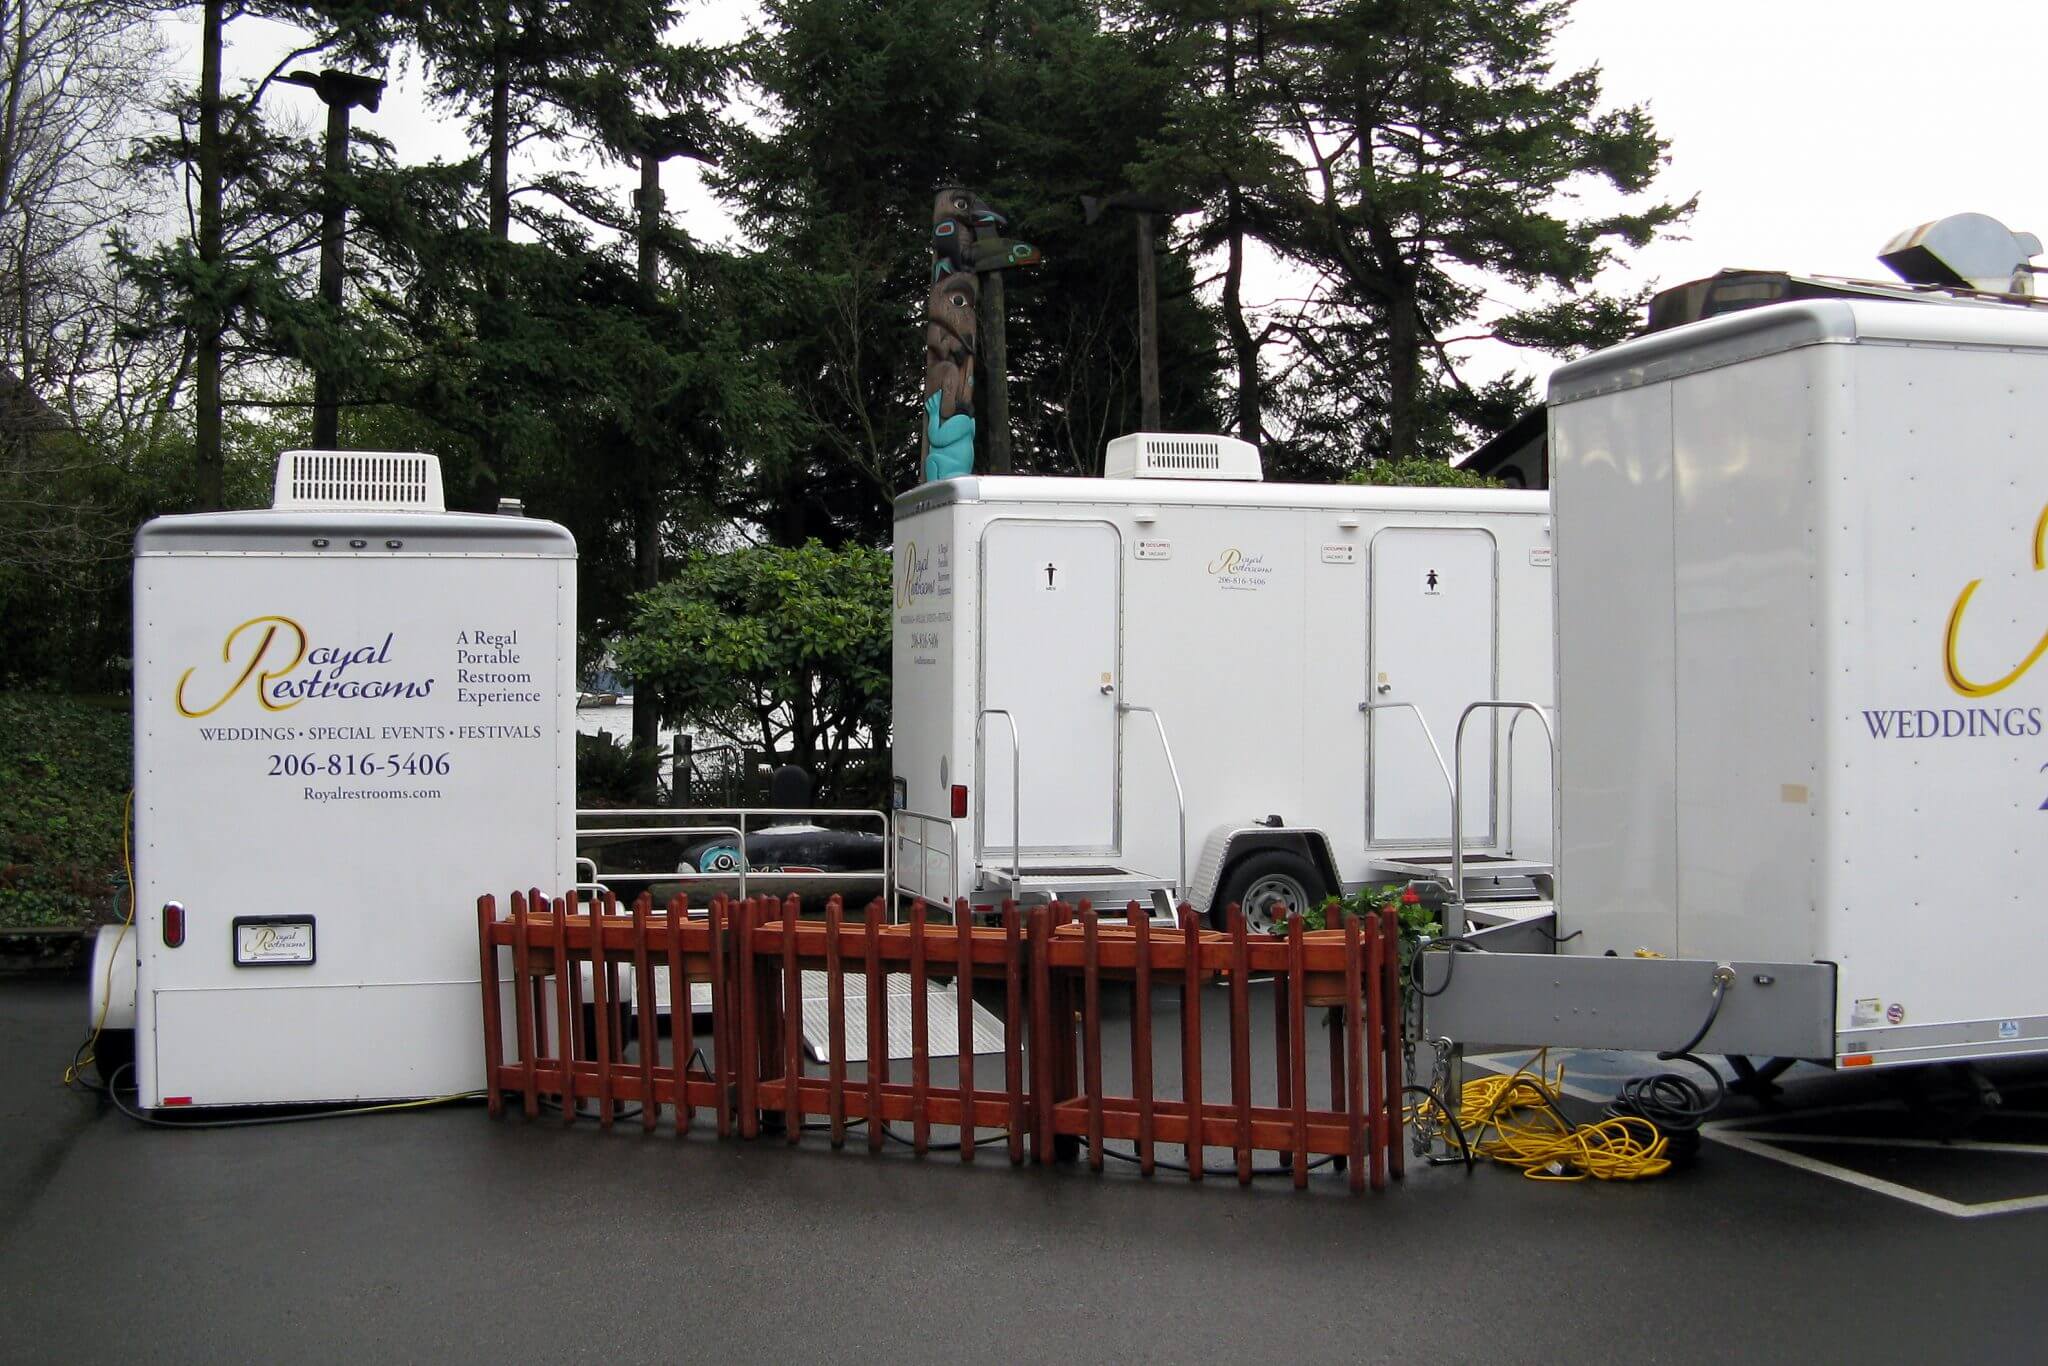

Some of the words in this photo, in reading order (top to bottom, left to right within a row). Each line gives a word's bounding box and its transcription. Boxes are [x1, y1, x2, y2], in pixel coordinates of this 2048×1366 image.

[456, 630, 469, 645] A
[474, 629, 518, 650] Regal
[176, 615, 395, 718] Royal
[457, 649, 521, 664] Portable
[457, 668, 532, 683] Restroom
[457, 687, 542, 707] Experience
[200, 727, 296, 741] WEDDINGS
[307, 727, 376, 740] SPECIAL
[382, 726, 446, 740] EVENTS
[458, 725, 542, 739] FESTIVALS
[1862, 707, 2042, 739] WEDDINGS
[267, 751, 451, 778] 206-816-5406
[303, 786, 442, 803] Royalrestrooms.com
